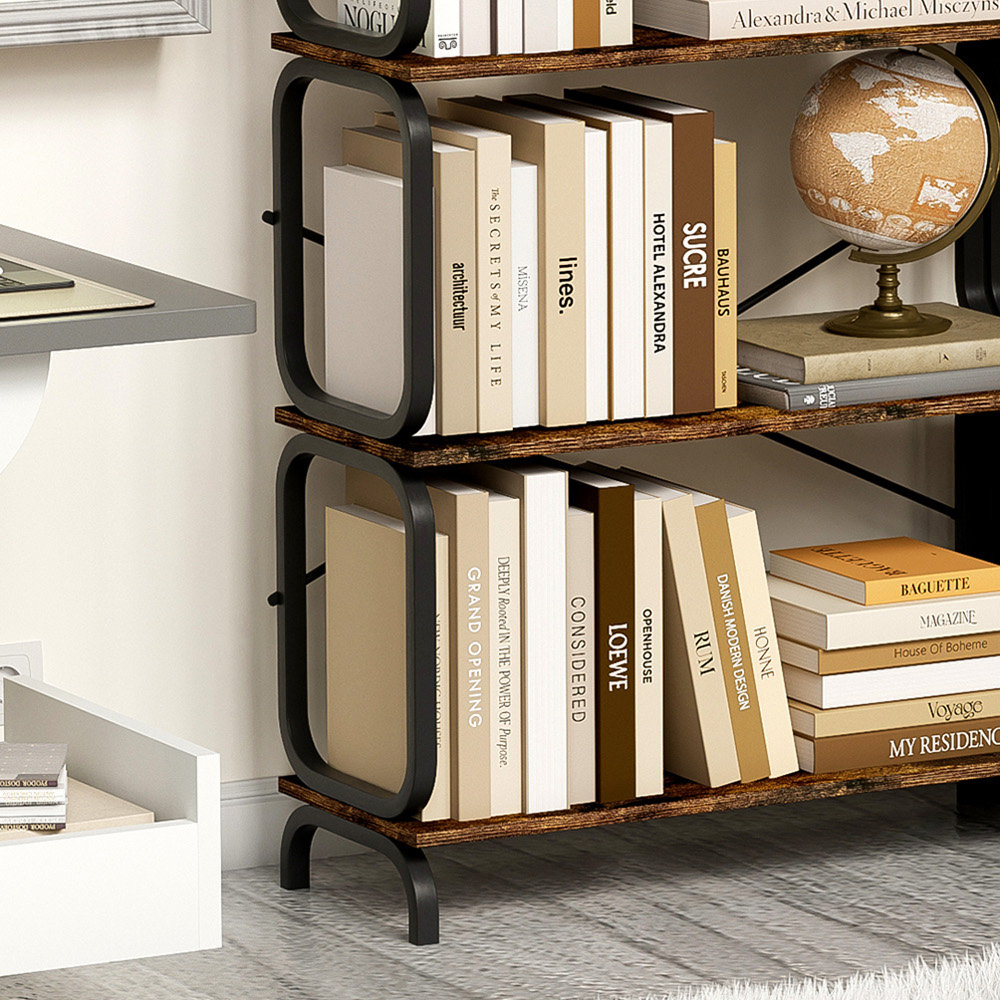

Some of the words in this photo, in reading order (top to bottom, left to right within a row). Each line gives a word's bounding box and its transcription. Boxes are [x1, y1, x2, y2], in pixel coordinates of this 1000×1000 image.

[491, 188, 500, 200] The
[489, 204, 501, 290] SECRETS
[653, 213, 666, 261] HOTEL
[682, 222, 707, 289] SUCRE
[452, 262, 468, 331] architectuur
[492, 293, 499, 301] of
[558, 257, 578, 315] lines.
[717, 248, 730, 317] BAUHAUS
[490, 305, 501, 330] MY
[653, 264, 666, 354] ALEXANDRA
[490, 343, 502, 387] LIFE
[497, 556, 511, 596] DEEPLY
[717, 573, 734, 617] DANISH
[900, 577, 970, 597] BAGUETTE
[467, 567, 482, 633] GRAND
[498, 597, 511, 631] Rooted
[920, 610, 978, 629] MAGAZINE
[498, 631, 511, 644] IN
[498, 646, 511, 667] THE
[570, 596, 586, 723] CONSIDERED
[608, 623, 628, 692] LOEWE
[642, 608, 653, 684] OPENHOUSE
[694, 630, 716, 677] RUM
[725, 617, 743, 668] MODERN
[754, 626, 775, 680] HONNE
[468, 641, 483, 728] OPENING
[498, 671, 511, 709] POWER
[733, 668, 751, 711] DESIGN
[499, 711, 511, 725] OF
[927, 700, 984, 721] Voyage
[496, 728, 512, 768] Purpose.
[889, 738, 916, 759] MY
